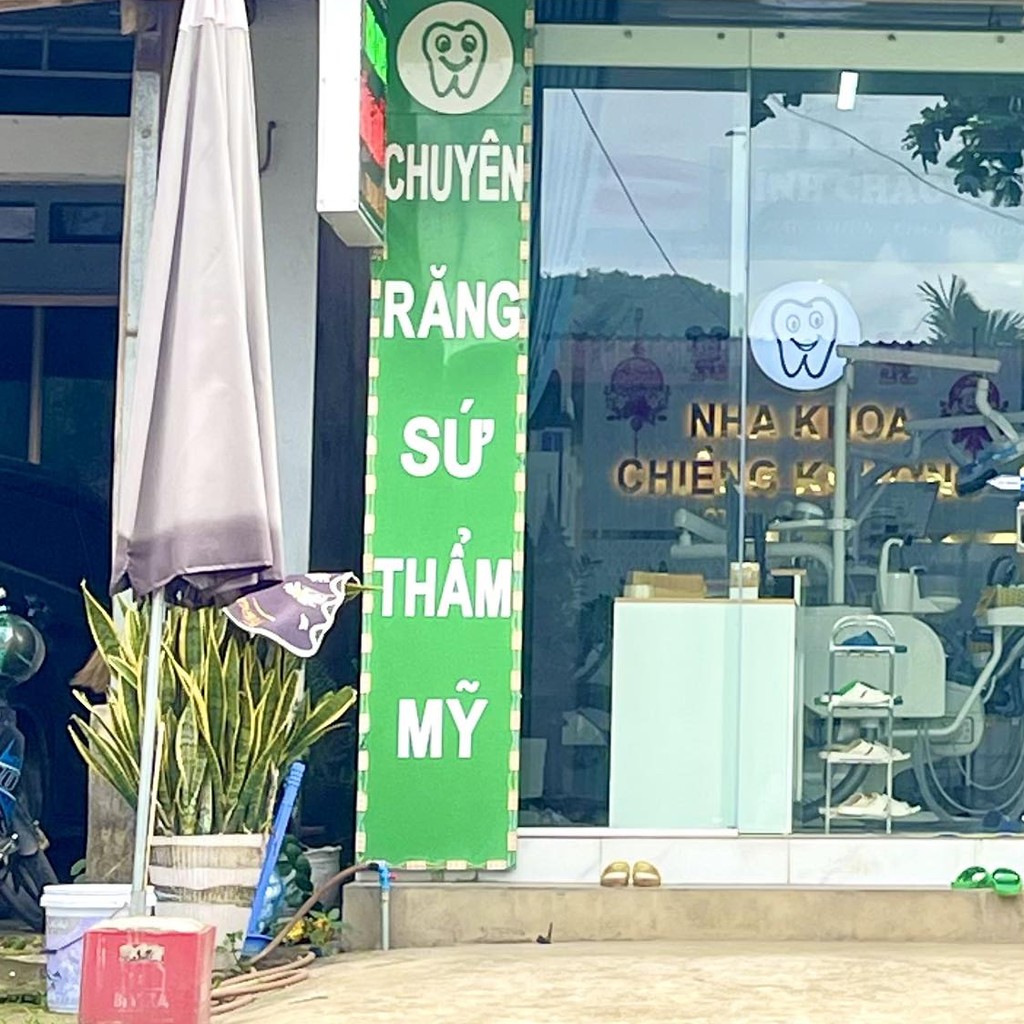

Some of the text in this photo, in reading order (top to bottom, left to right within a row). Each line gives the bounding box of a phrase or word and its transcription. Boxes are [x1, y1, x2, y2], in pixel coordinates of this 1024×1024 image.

[385, 129, 524, 202] CHUYÊN
[384, 264, 521, 340] RĂNG
[400, 398, 495, 479] SỨ
[375, 527, 513, 618] THẨM
[397, 679, 489, 759] MỸ
